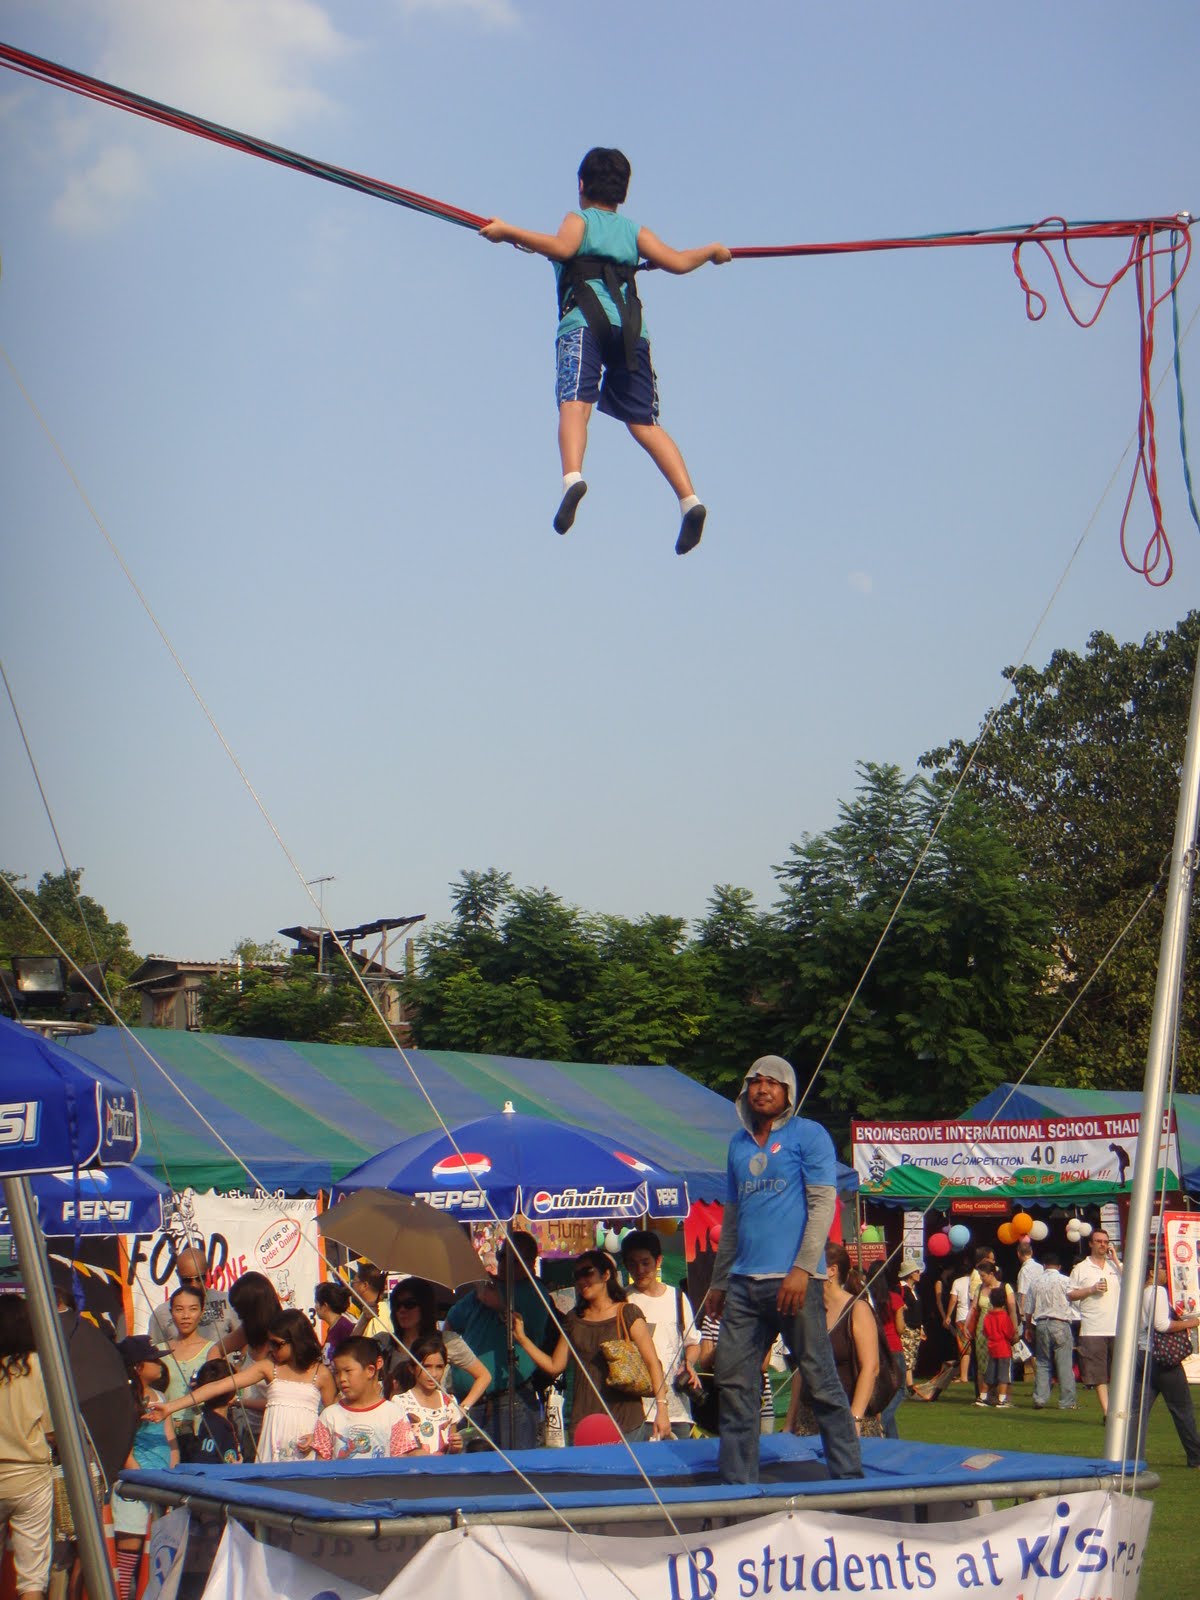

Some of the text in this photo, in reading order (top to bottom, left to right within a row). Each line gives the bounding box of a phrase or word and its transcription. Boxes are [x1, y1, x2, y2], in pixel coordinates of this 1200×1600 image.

[856, 1126, 943, 1141] BROMSGROVE
[945, 1124, 1045, 1140] INTERNATIONAL
[1047, 1121, 1102, 1138] SCHOOL
[1031, 1145, 1056, 1165] 40
[1060, 1154, 1088, 1164] BAHT
[939, 1176, 975, 1187] GREAT
[978, 1176, 1017, 1187] PRIZES
[1022, 1176, 1037, 1185] TO
[1041, 1175, 1055, 1184] BE
[1060, 1170, 1090, 1182] WON
[62, 1200, 133, 1222] PEPSI
[260, 1224, 290, 1253] Call us or
[261, 1228, 299, 1265] Order Online
[201, 1437, 215, 1453] 10
[668, 1547, 717, 1600] IB
[738, 1536, 937, 1598] students
[955, 1539, 1004, 1588] at
